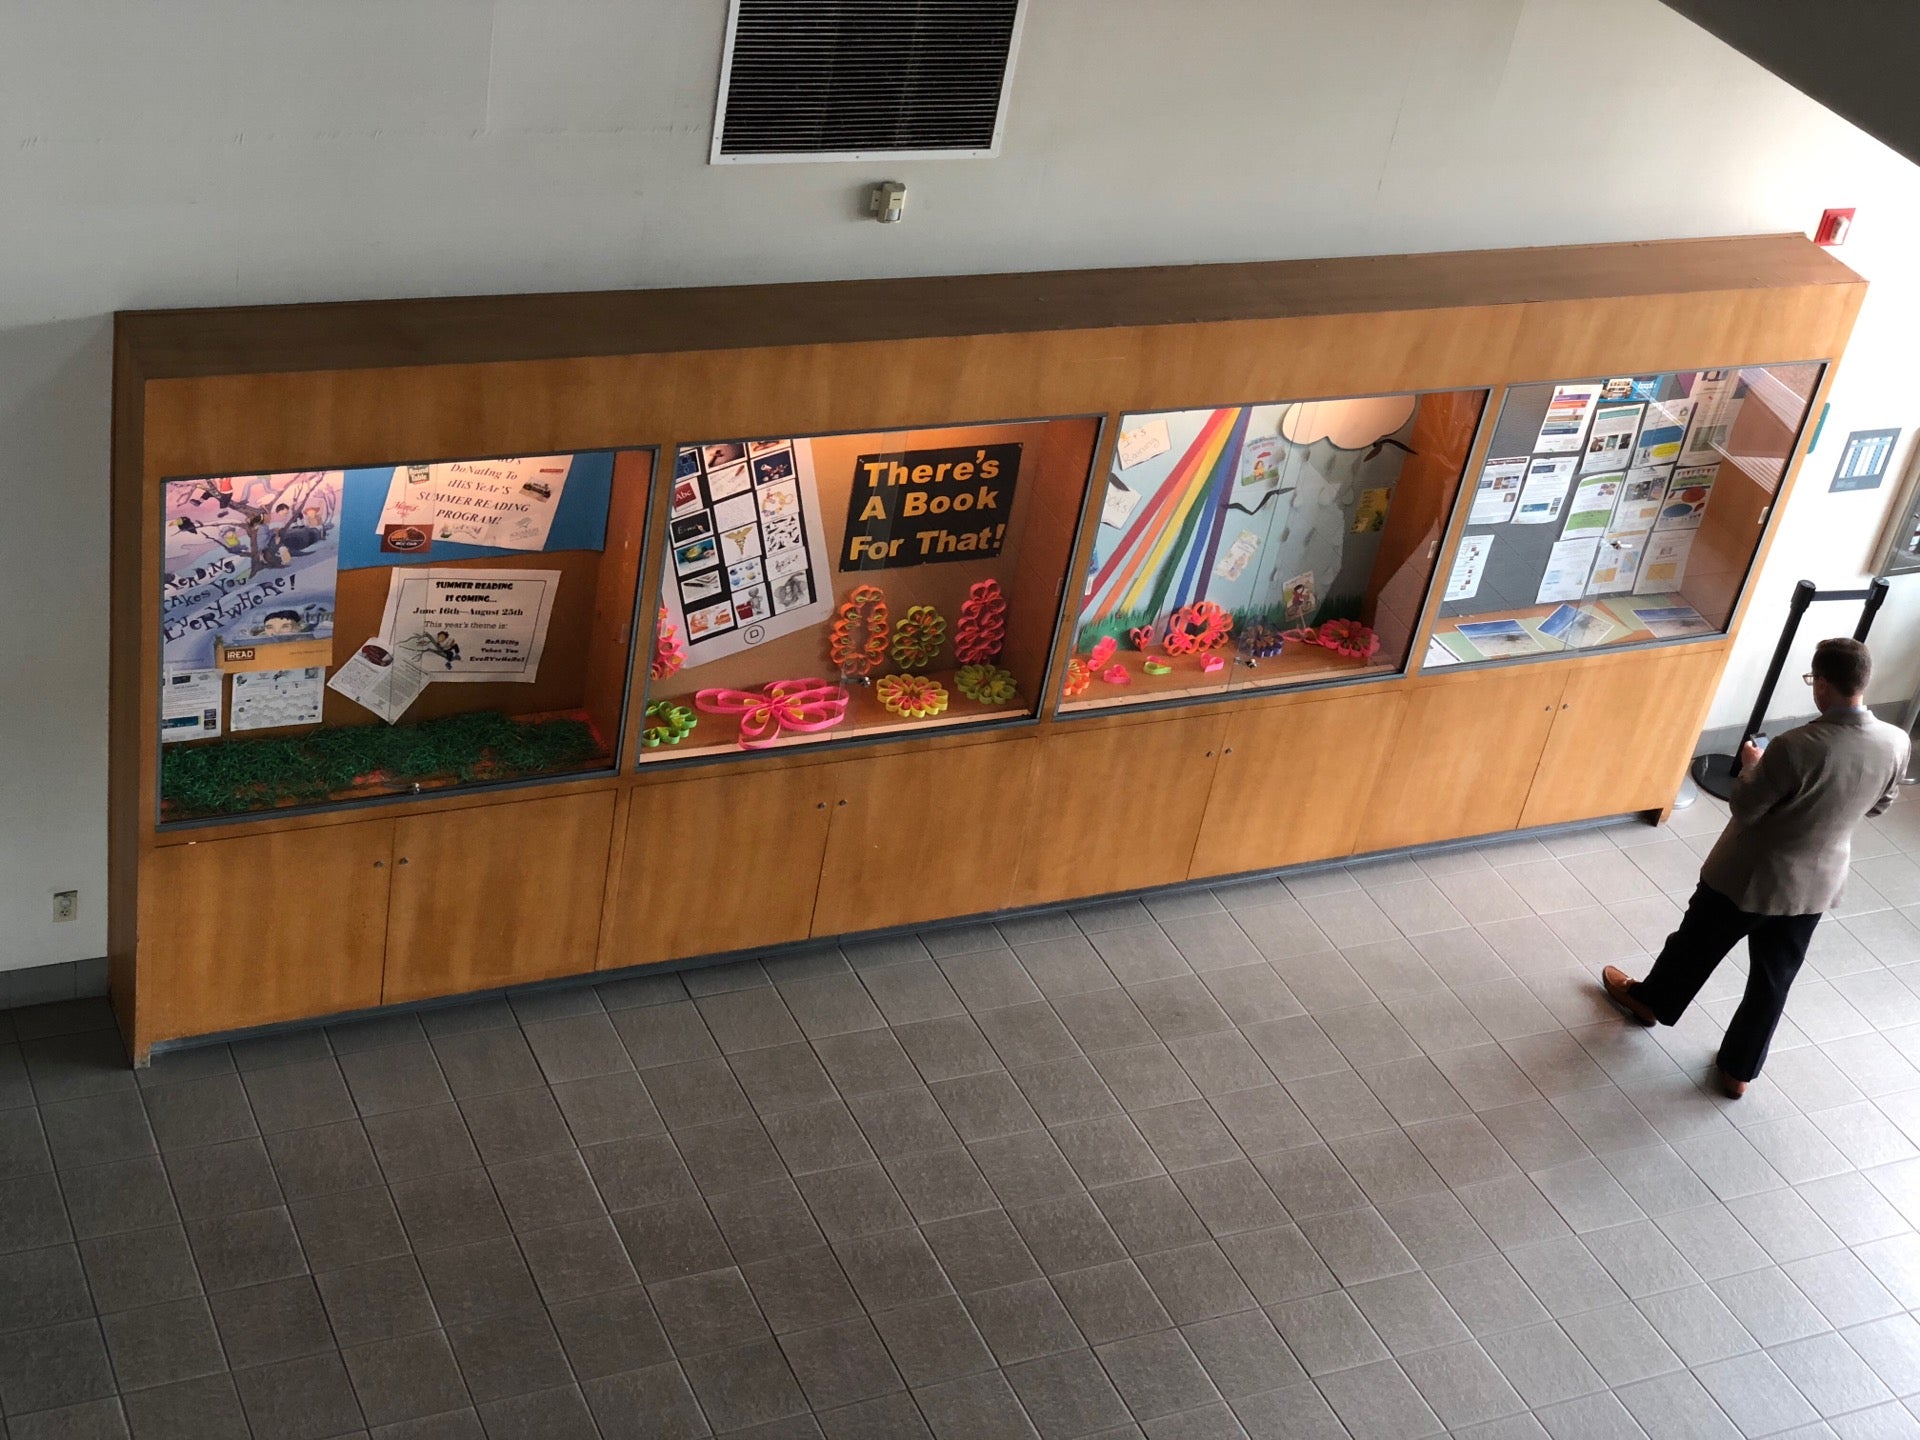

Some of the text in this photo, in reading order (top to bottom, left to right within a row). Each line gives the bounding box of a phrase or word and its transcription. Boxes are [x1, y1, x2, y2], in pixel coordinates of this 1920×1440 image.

[506, 470, 518, 480] To
[863, 450, 1000, 487] There's
[416, 491, 531, 512] SUMMER READING
[675, 489, 692, 501] Abc
[859, 486, 999, 521] A Book
[436, 509, 502, 525] PROGRAM!
[850, 523, 1006, 561] For That!
[455, 595, 497, 603] COMING...
[413, 607, 437, 615] June
[445, 622, 468, 630] year's
[470, 622, 497, 630] theme
